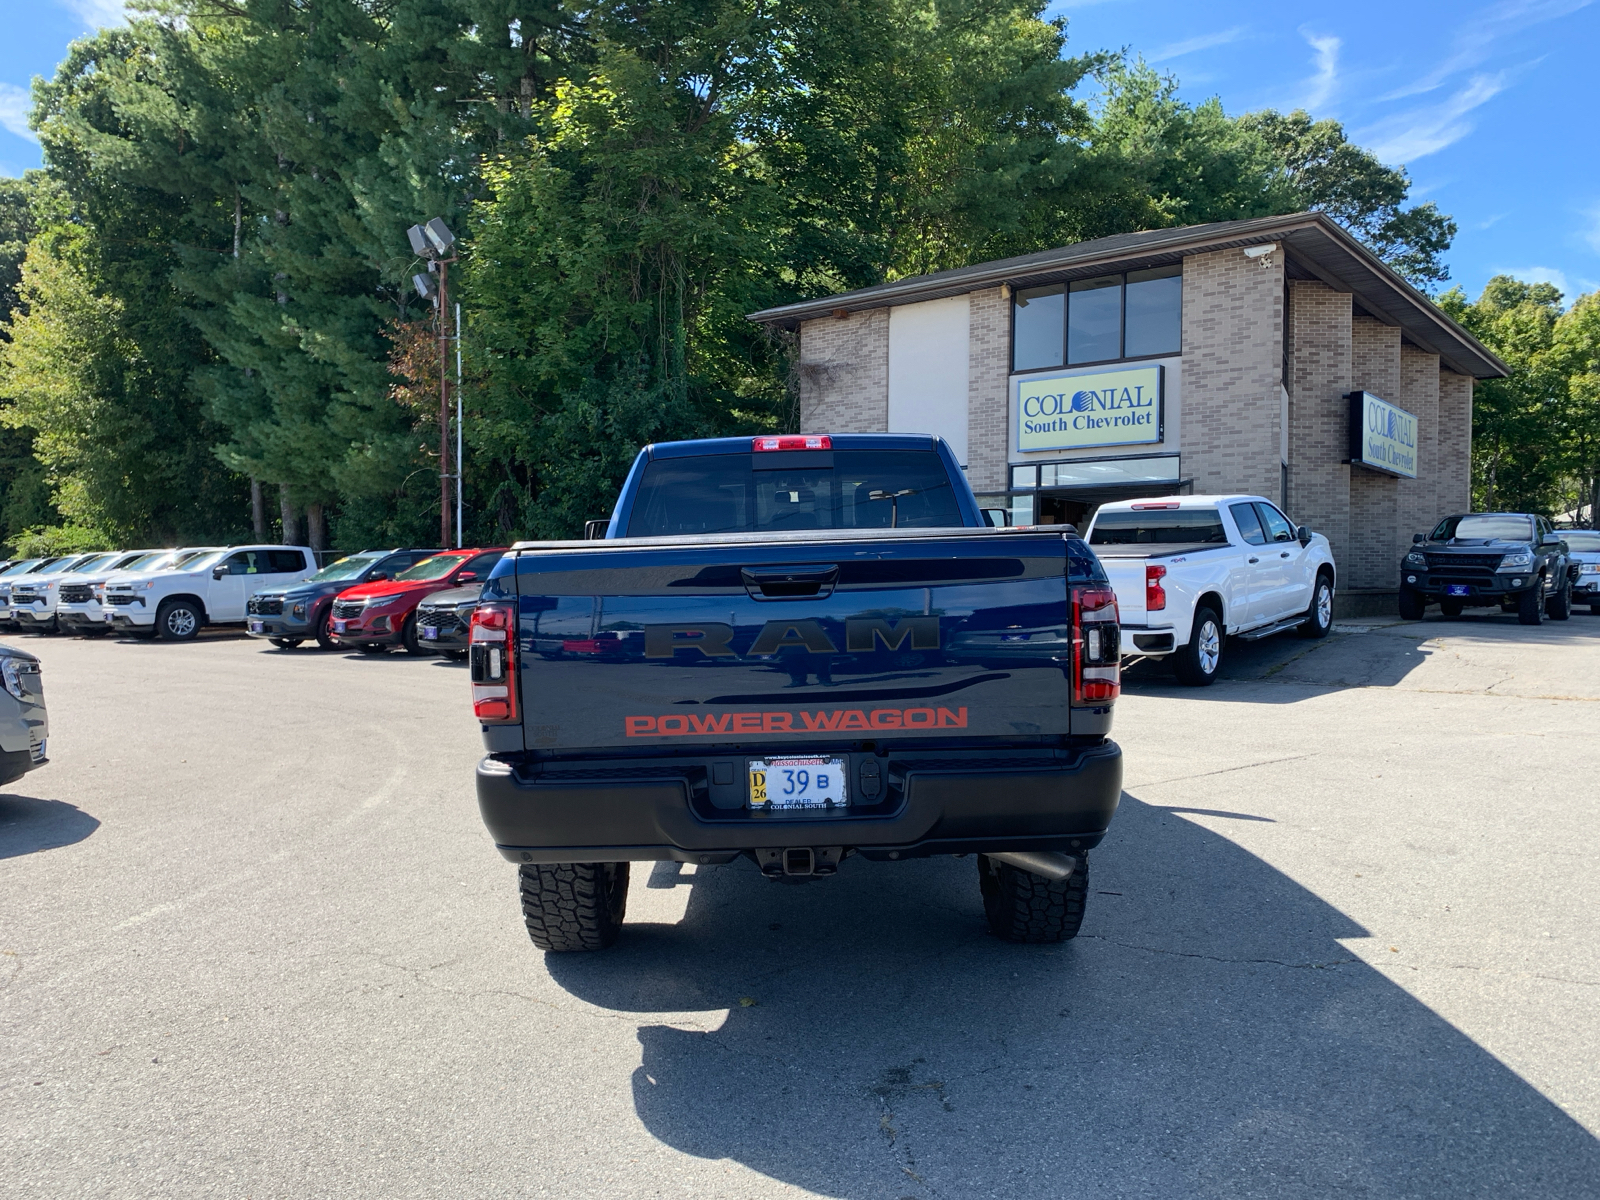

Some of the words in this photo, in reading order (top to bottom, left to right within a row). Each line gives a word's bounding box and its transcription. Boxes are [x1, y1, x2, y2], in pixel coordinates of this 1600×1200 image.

[1024, 386, 1152, 418] COLONIAL
[1024, 418, 1067, 434] South
[1072, 410, 1152, 430] Chevrolet
[1368, 401, 1414, 448] COLONIAL
[1368, 436, 1386, 461] South
[1387, 443, 1414, 471] Chevrolet
[645, 615, 940, 659] RAM
[625, 712, 793, 738] POWER
[799, 707, 968, 733] WAGON
[753, 773, 766, 787] D
[754, 789, 766, 799] 26
[782, 770, 809, 795] 39
[817, 774, 829, 789] B
